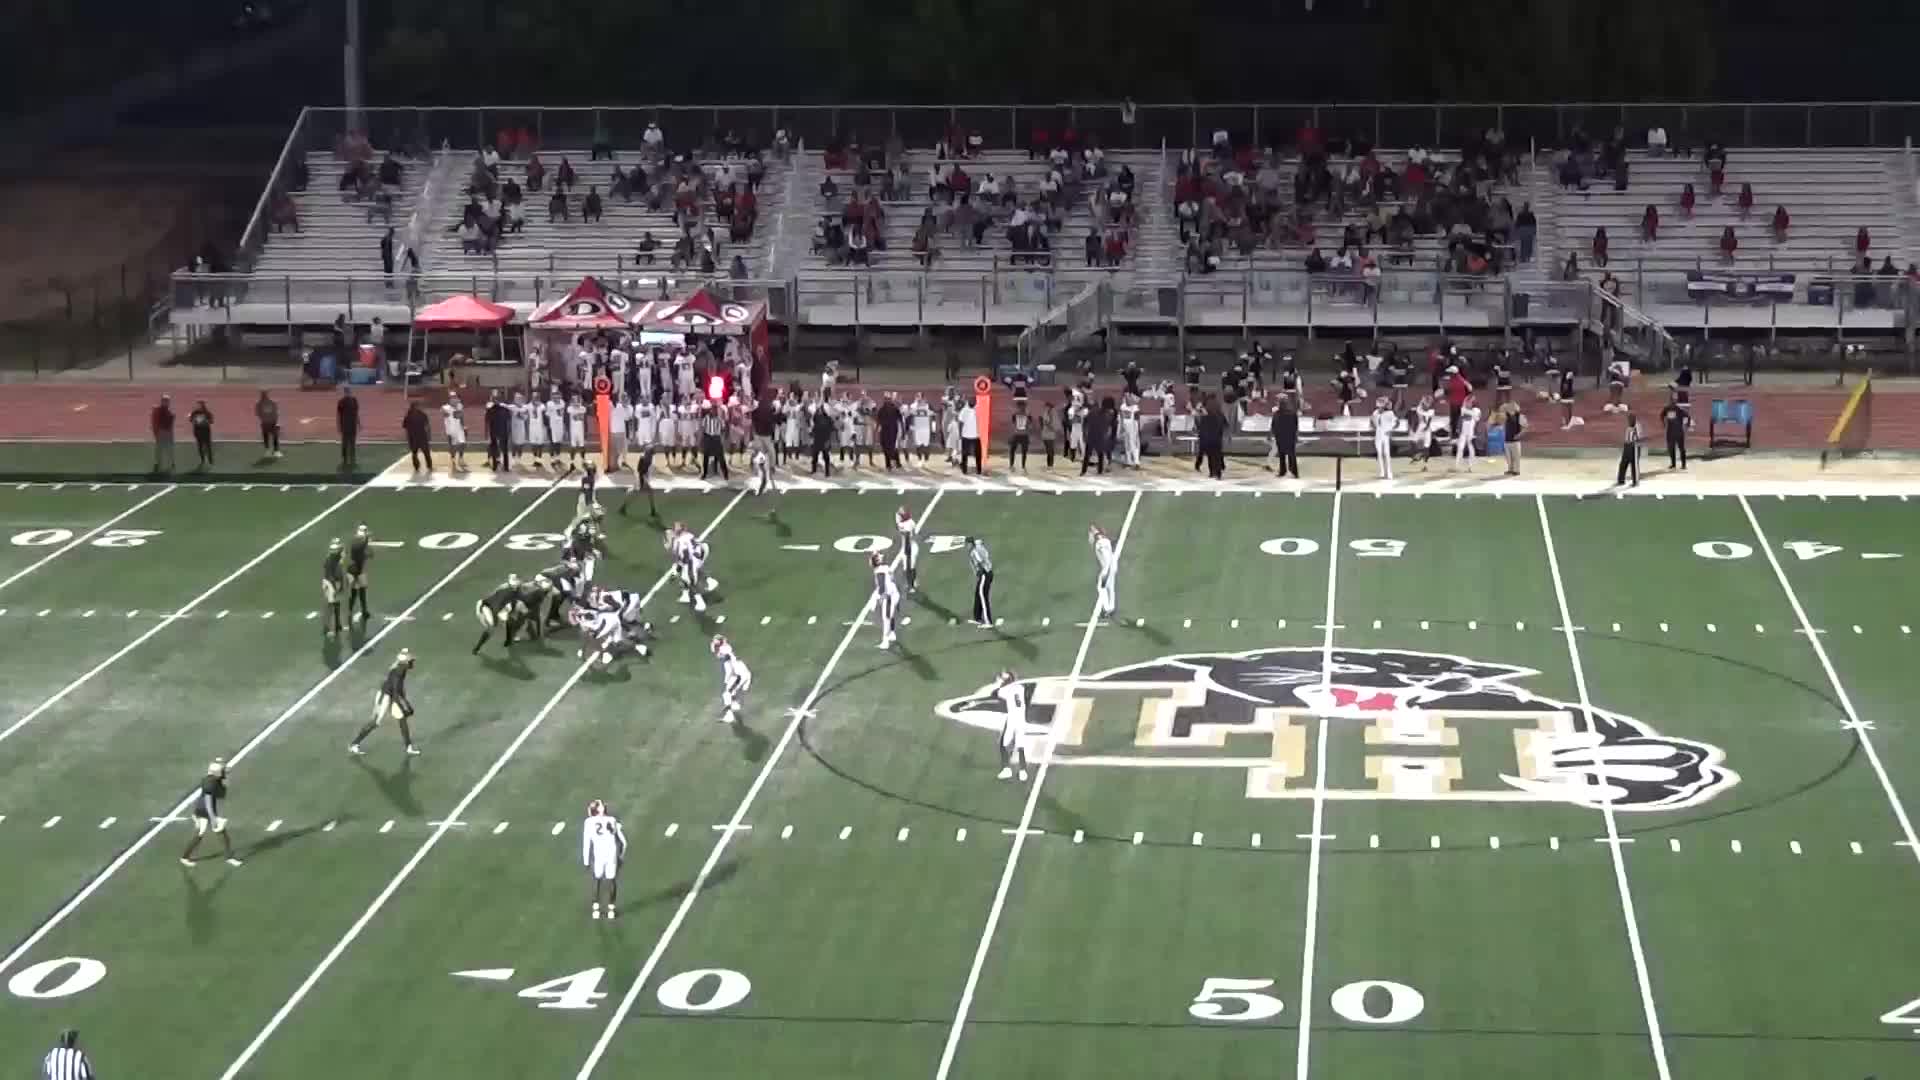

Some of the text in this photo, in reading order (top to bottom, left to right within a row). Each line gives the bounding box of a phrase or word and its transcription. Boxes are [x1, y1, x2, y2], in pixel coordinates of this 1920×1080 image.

[1260, 537, 1408, 557] 50
[595, 821, 616, 836] 24
[517, 967, 751, 1010] 40
[1188, 978, 1425, 1024] 50
